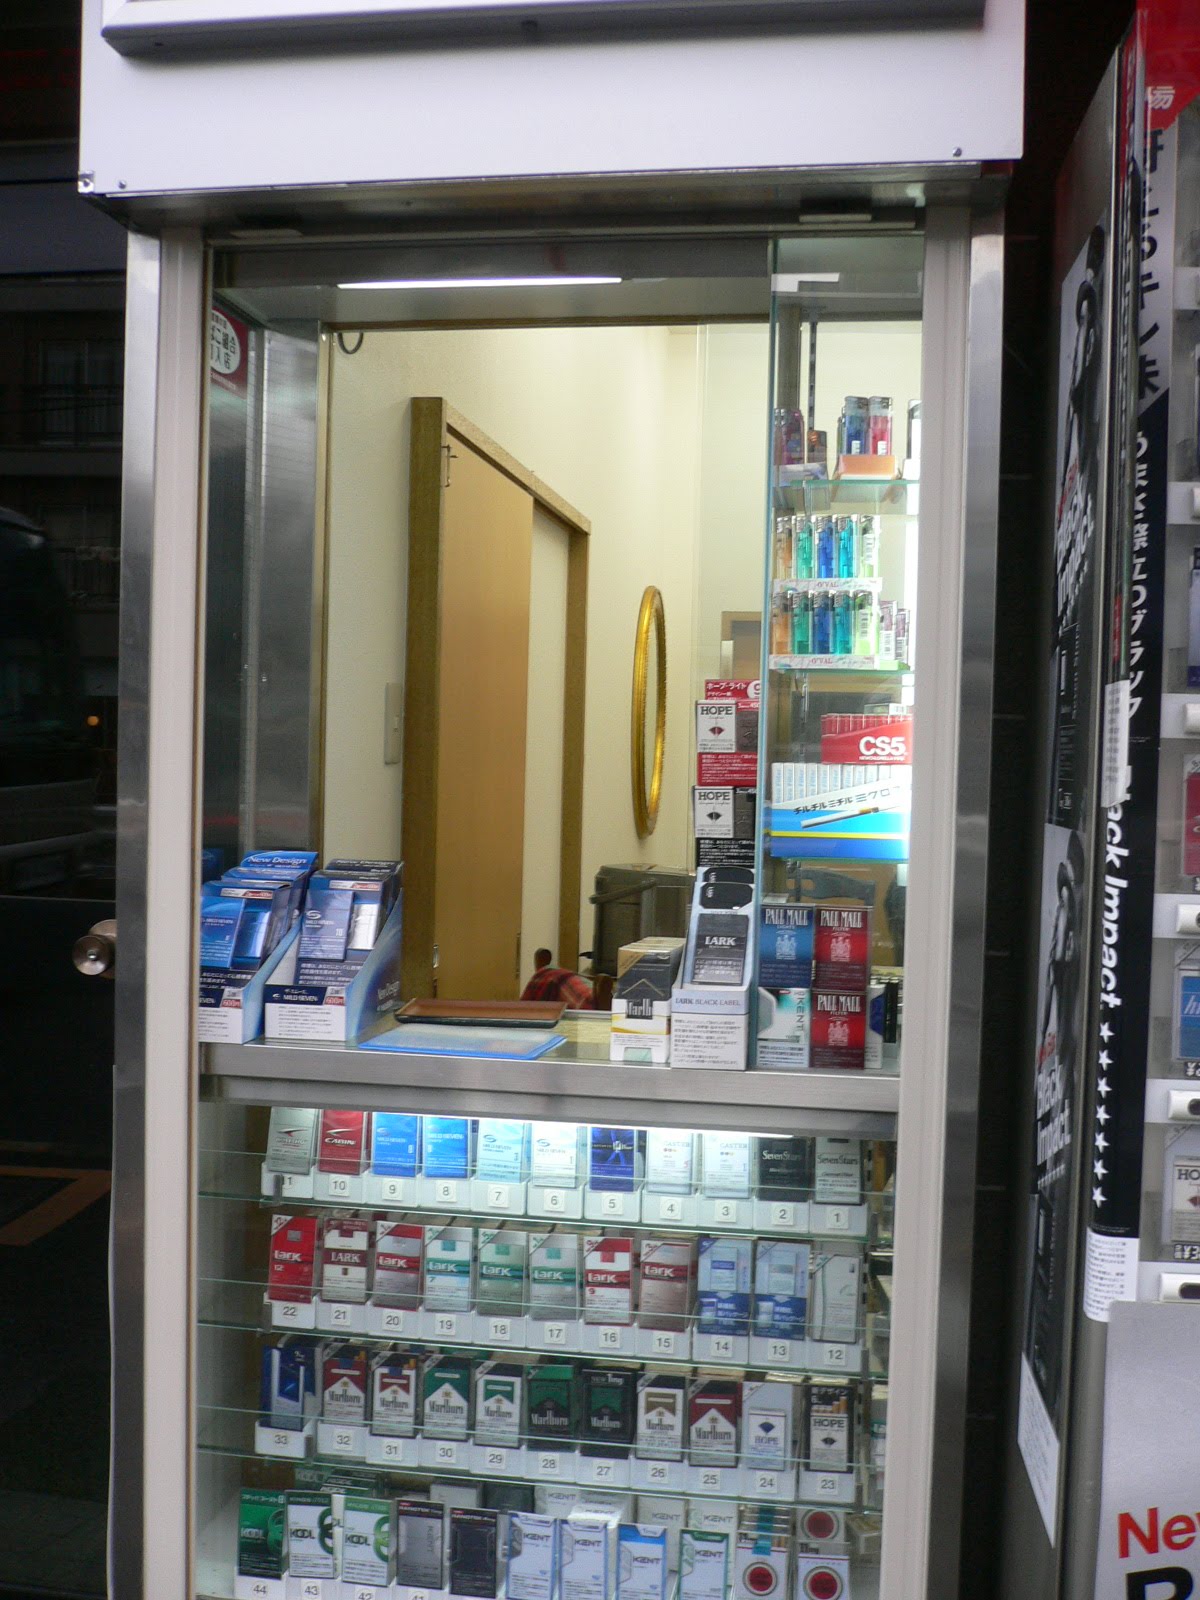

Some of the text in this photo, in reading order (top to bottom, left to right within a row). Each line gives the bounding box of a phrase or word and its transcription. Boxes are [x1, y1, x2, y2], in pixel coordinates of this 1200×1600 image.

[700, 706, 733, 715] HOPE
[859, 736, 906, 756] CS5
[697, 791, 730, 801] HOPE
[765, 909, 808, 926] PALL MALL
[820, 911, 862, 928] PALL MALL
[705, 936, 736, 946] LARK
[695, 998, 718, 1006] BLACK
[817, 995, 861, 1012] PALL MALL
[333, 1181, 346, 1191] 10
[389, 1185, 396, 1195] 9
[442, 1187, 450, 1196] 8
[494, 1191, 502, 1201] 7
[551, 1196, 558, 1206] 6
[608, 1199, 616, 1209] 5
[667, 1203, 675, 1213] 4
[722, 1206, 729, 1216] 3
[779, 1209, 786, 1219] 2
[834, 1213, 840, 1222] 1
[331, 1252, 361, 1263] LARK
[588, 1287, 595, 1295] 9
[283, 1306, 296, 1316] 22
[334, 1309, 346, 1320] 21
[386, 1315, 399, 1325] 20
[440, 1320, 452, 1330] 19
[493, 1324, 506, 1335] 18
[549, 1328, 562, 1338] 17
[603, 1332, 617, 1342] 16
[657, 1337, 670, 1348] 15
[715, 1341, 728, 1351] 14
[773, 1345, 786, 1356] 13
[828, 1350, 842, 1360] 12
[813, 1418, 845, 1428] HOPE
[274, 1435, 287, 1445] 33
[337, 1435, 349, 1445] 32
[755, 1436, 778, 1445] HOPE
[386, 1445, 398, 1455] 31
[440, 1447, 453, 1457] 30
[489, 1454, 502, 1463] 29
[542, 1459, 556, 1468] 28
[597, 1466, 610, 1476] 27
[651, 1468, 665, 1478] 26
[703, 1475, 717, 1485] 25
[760, 1477, 774, 1488] 24
[821, 1480, 835, 1490] 23
[290, 1528, 315, 1539] KOOL
[523, 1533, 550, 1541] KENT
[345, 1535, 370, 1546] KOOL
[574, 1539, 602, 1547] KENT
[695, 1550, 723, 1558] KENT
[633, 1556, 661, 1564] KENT
[253, 1585, 268, 1595] 44
[304, 1586, 318, 1596] 43
